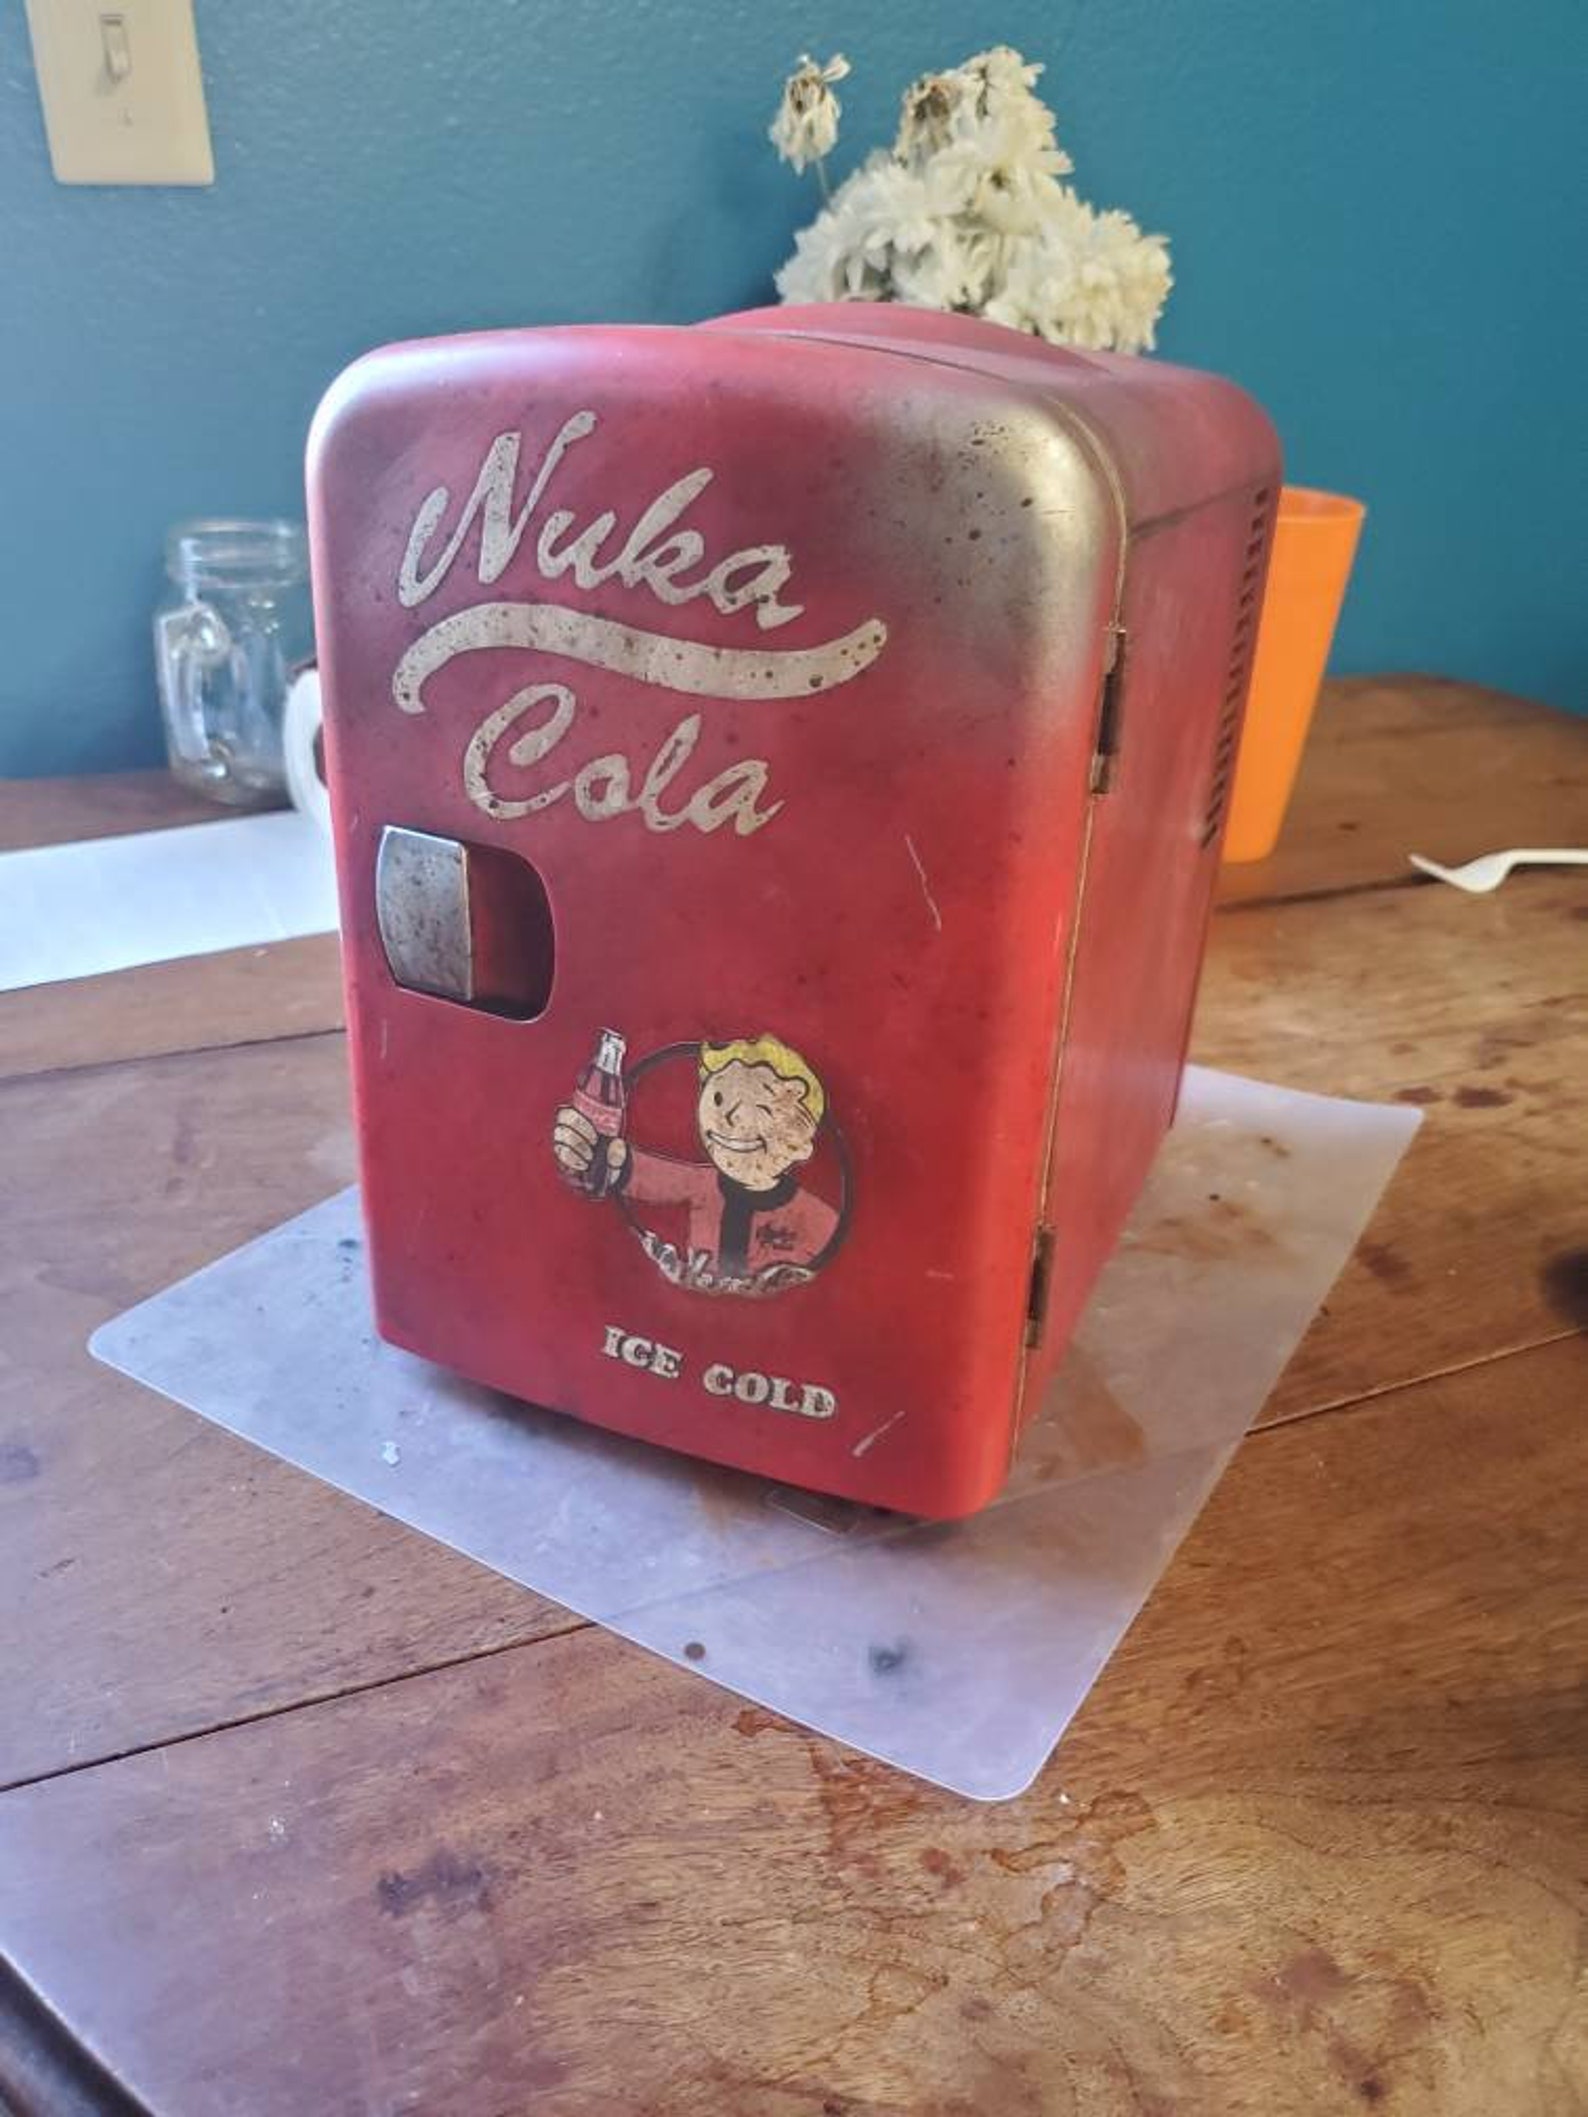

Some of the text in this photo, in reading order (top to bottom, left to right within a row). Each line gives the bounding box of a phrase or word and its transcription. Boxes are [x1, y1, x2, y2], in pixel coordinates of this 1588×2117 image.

[397, 410, 805, 630] Nuka
[463, 683, 786, 836] Cola
[602, 1324, 837, 1418] ICE COLD
